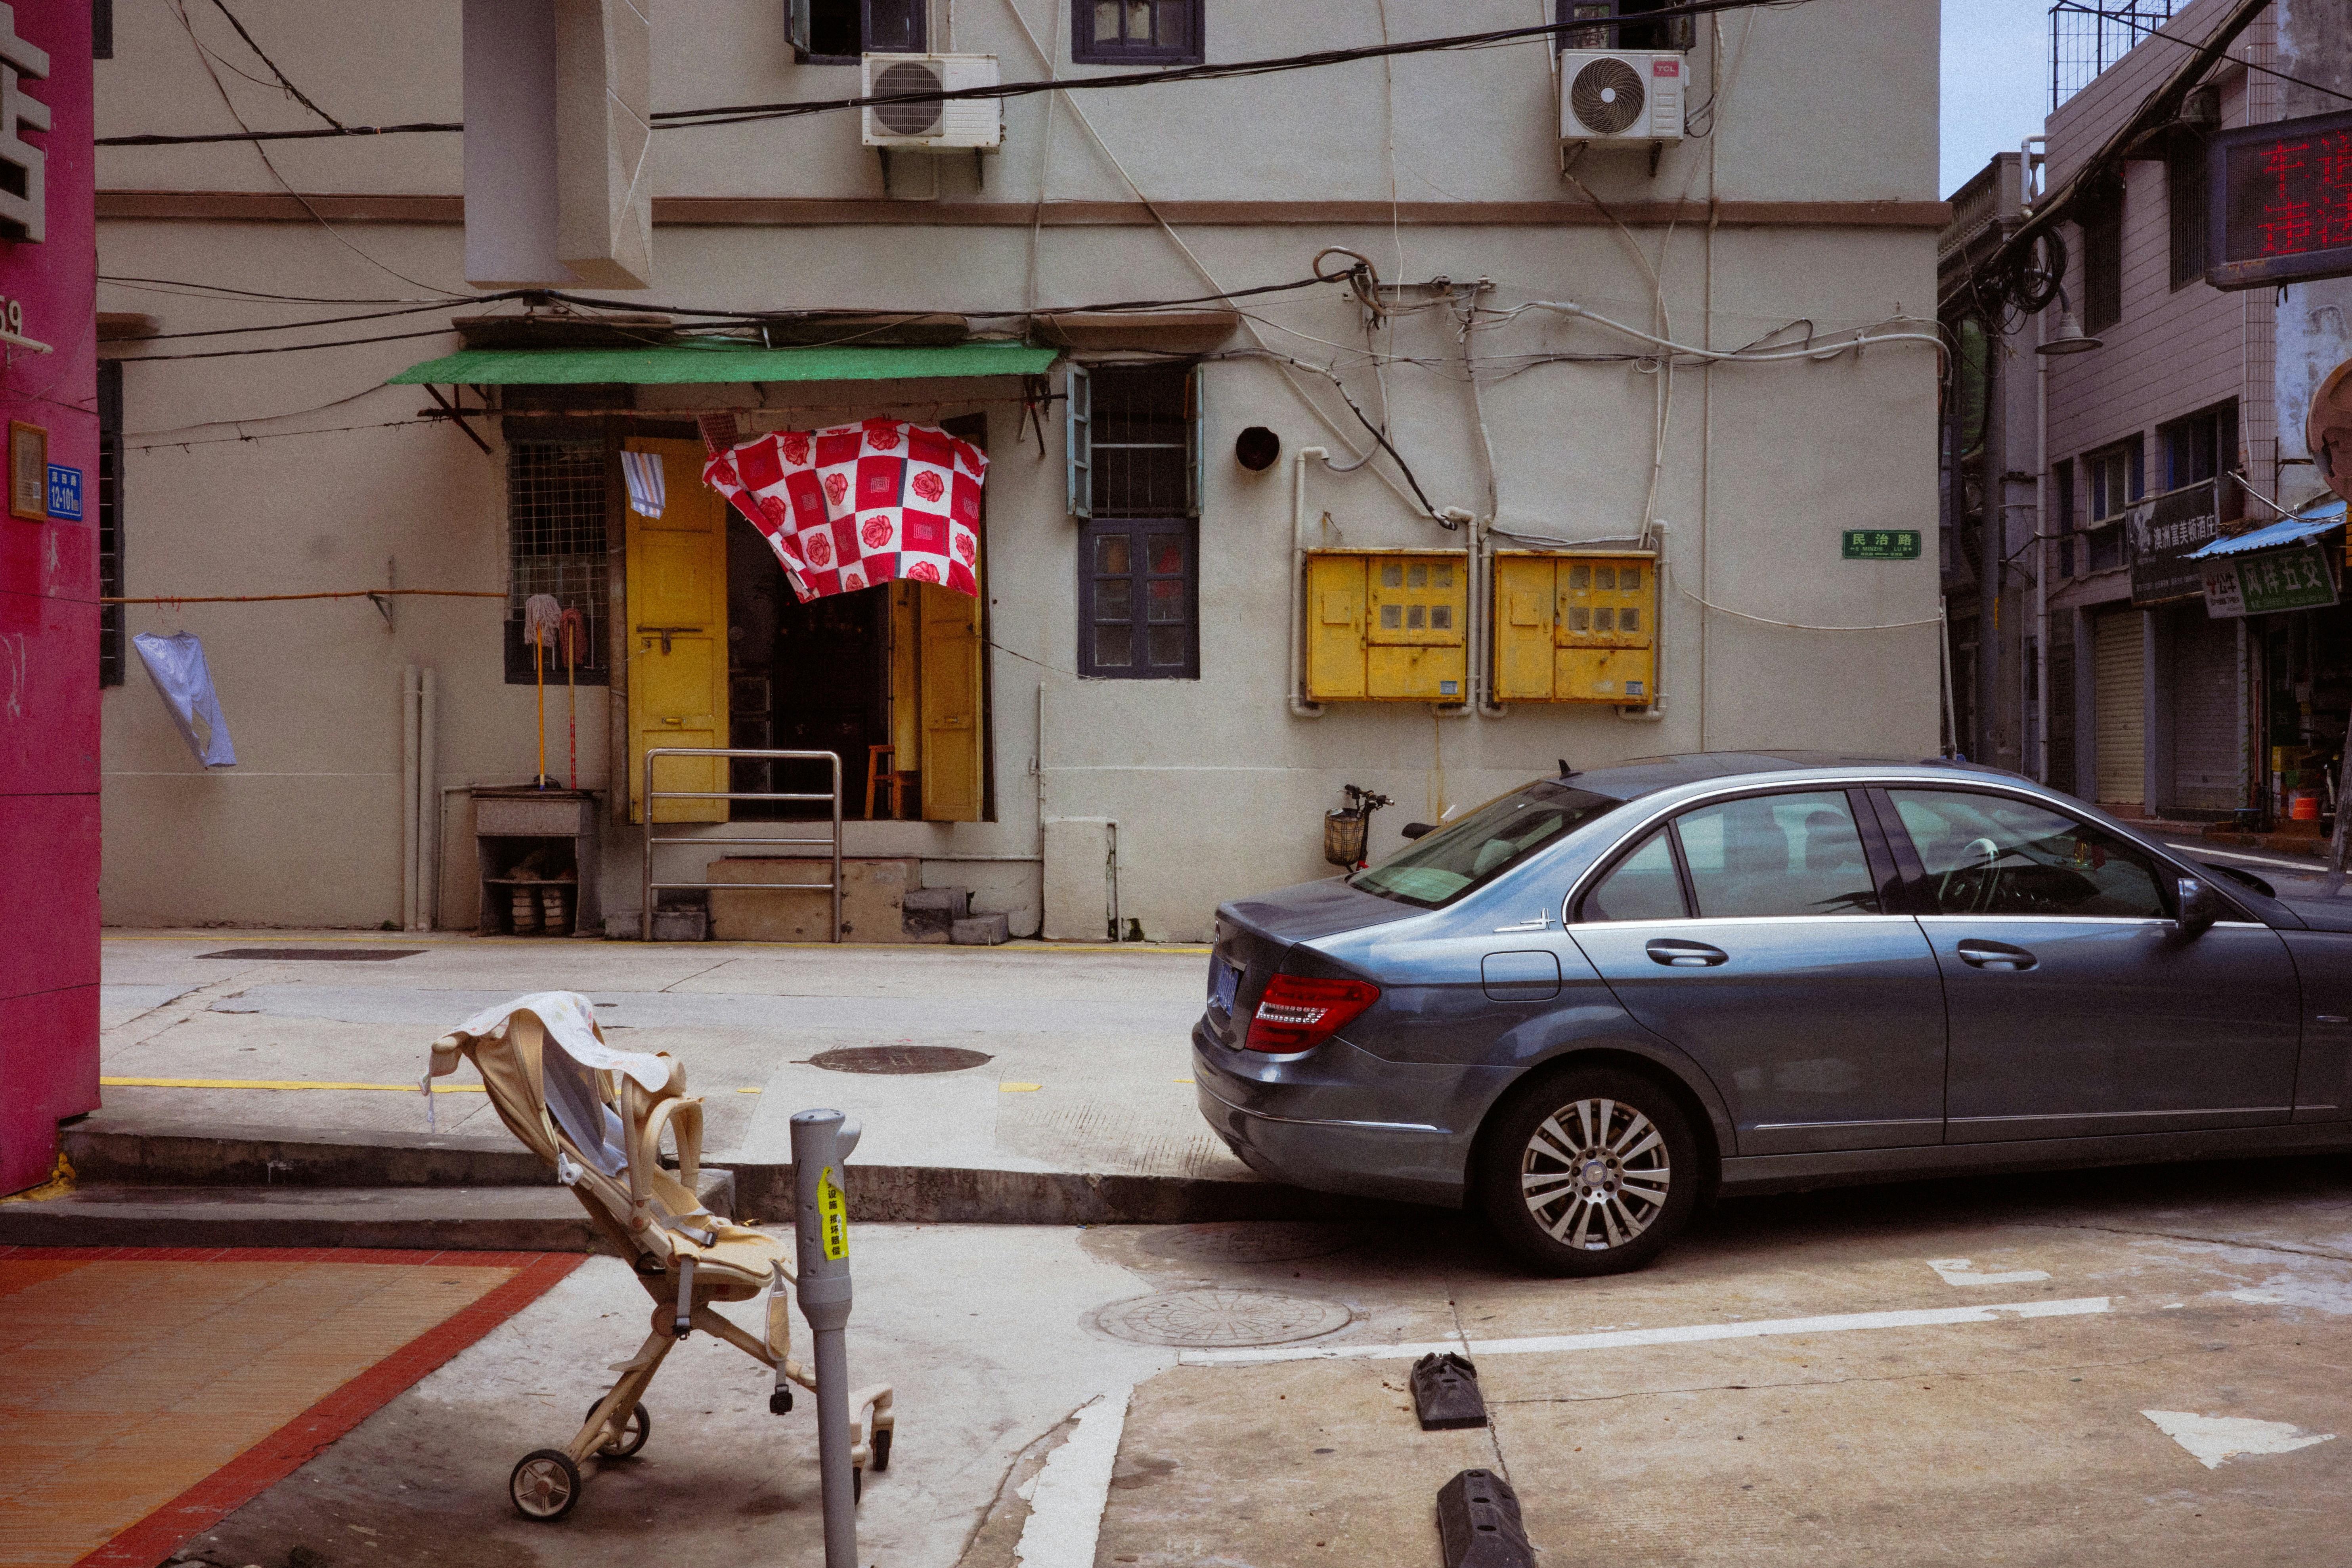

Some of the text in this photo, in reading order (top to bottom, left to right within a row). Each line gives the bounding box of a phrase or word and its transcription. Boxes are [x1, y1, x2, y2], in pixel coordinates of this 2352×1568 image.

[1853, 534, 1912, 546] 民治路
[2217, 573, 2236, 593] 公牛
